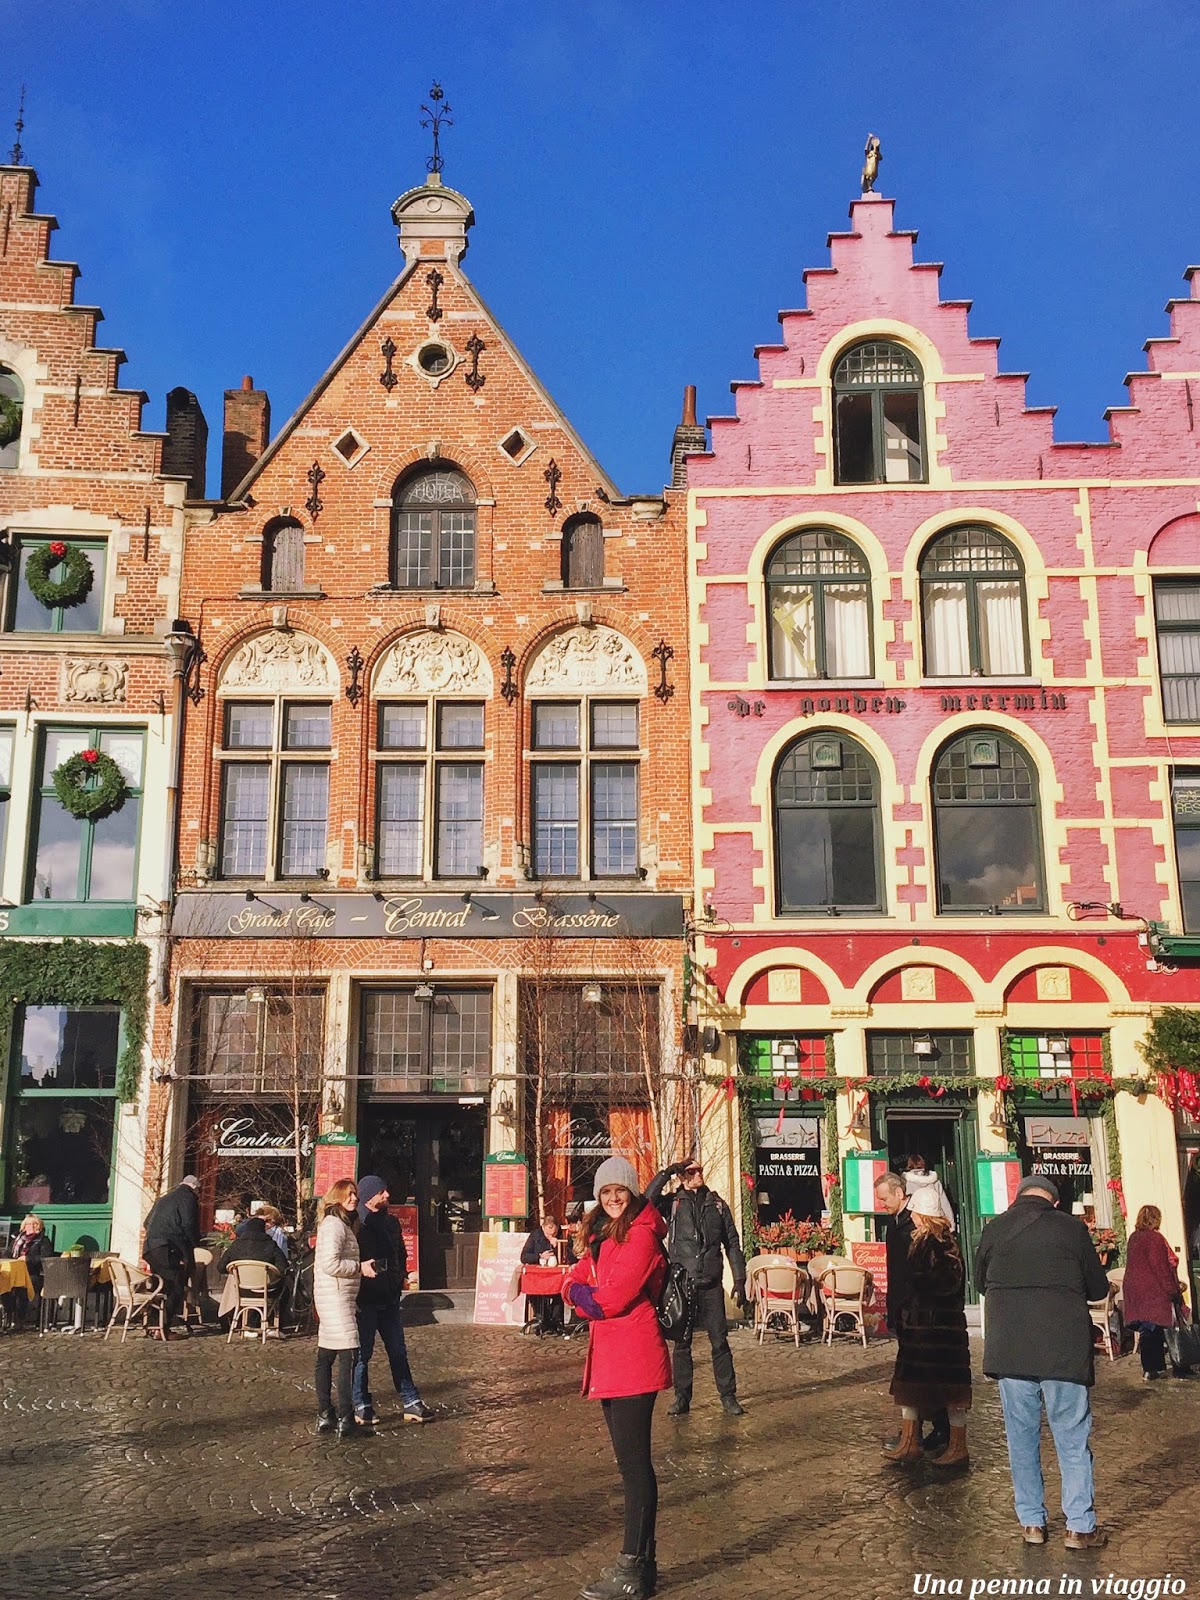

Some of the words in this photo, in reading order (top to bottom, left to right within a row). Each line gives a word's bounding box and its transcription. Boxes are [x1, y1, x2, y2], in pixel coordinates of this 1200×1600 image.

[415, 483, 460, 499] HOTEL
[800, 693, 899, 718] gouden
[940, 688, 1068, 712] meermin
[228, 907, 293, 934] Grand
[383, 897, 472, 934] Central
[220, 1118, 299, 1147] Central
[770, 1153, 806, 1161] BRASSERIE
[1043, 1152, 1079, 1160] BRASSERIE
[759, 1164, 785, 1176] PASTA
[786, 1164, 792, 1176] &
[793, 1164, 819, 1176] PIZZA
[1033, 1163, 1059, 1175] PASTA
[1060, 1163, 1067, 1175] &
[1068, 1163, 1093, 1175] PIZZA
